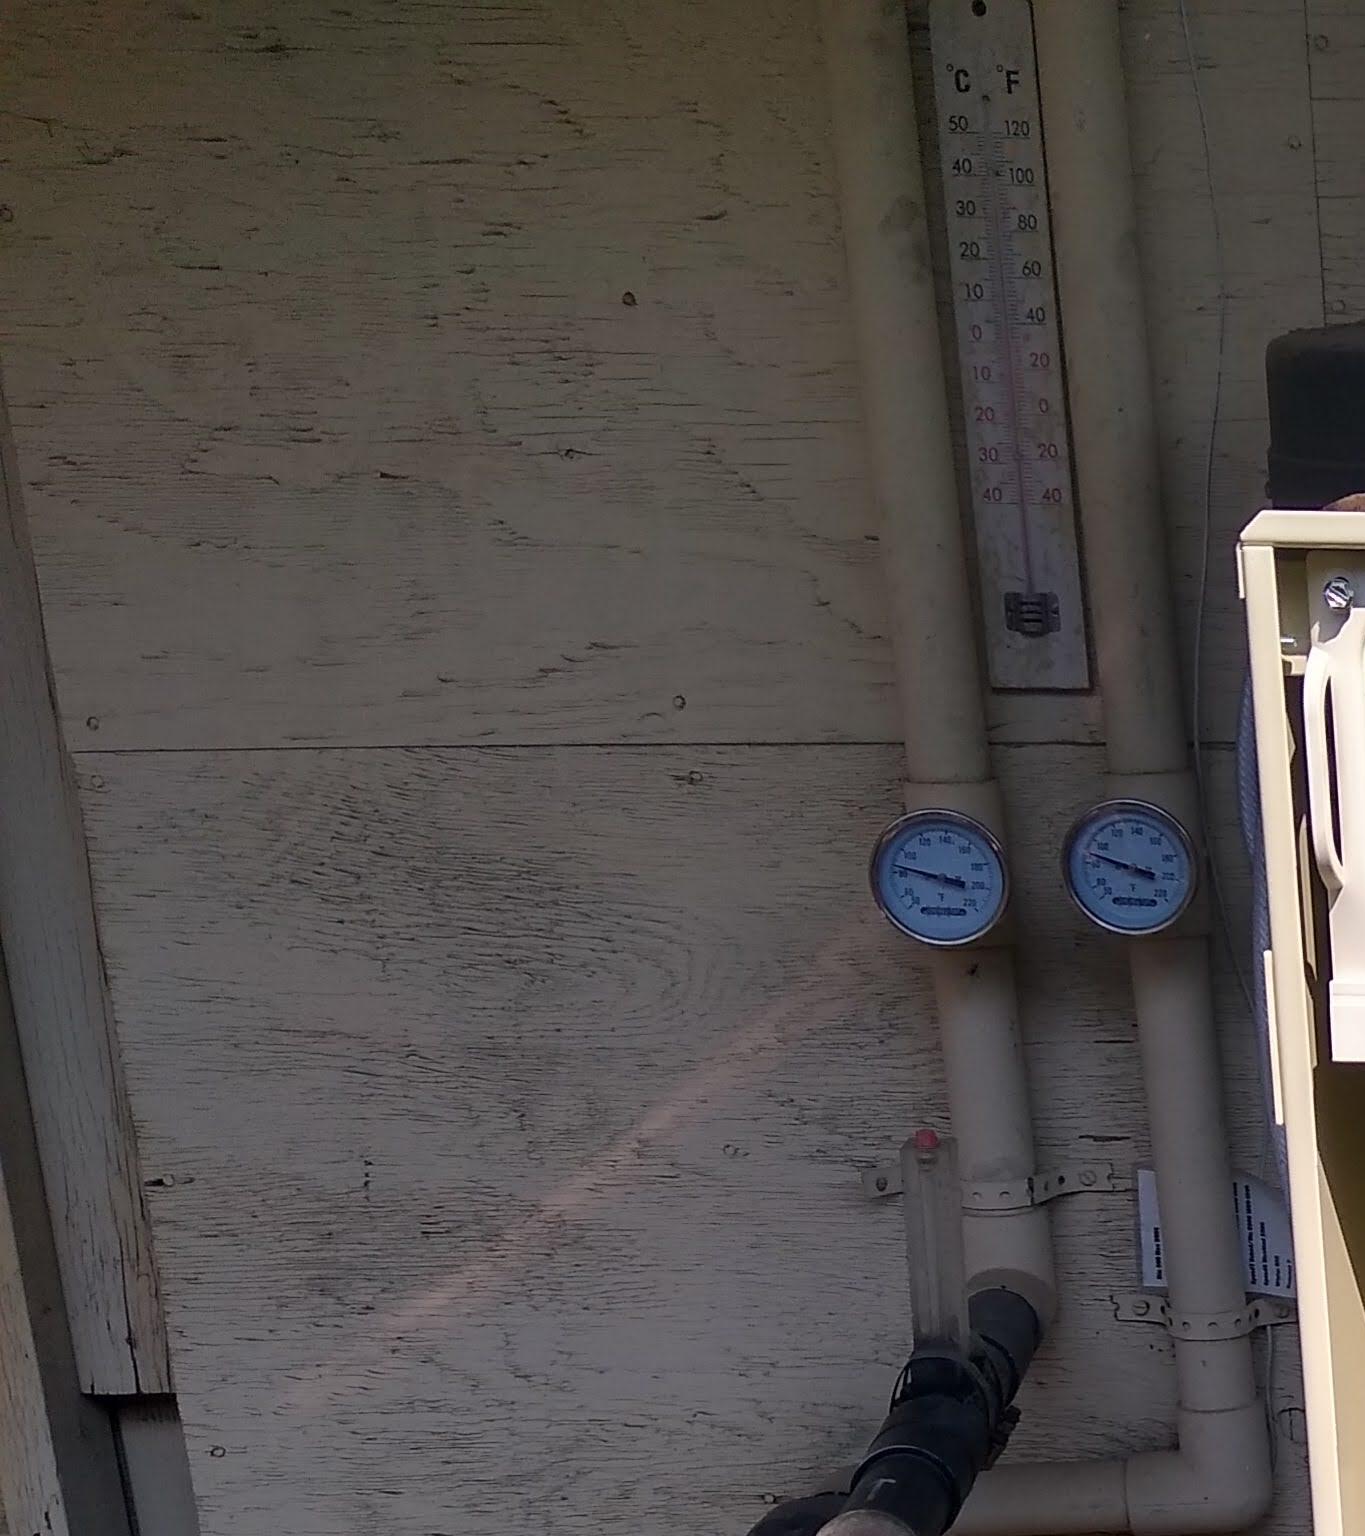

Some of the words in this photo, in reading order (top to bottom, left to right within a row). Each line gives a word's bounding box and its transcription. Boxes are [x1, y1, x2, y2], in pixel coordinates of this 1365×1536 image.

[949, 116, 968, 131] 50
[1005, 120, 1029, 136] 120
[952, 158, 971, 173] 40
[1010, 168, 1034, 183] 100
[956, 201, 976, 215] 30
[1018, 215, 1037, 230] 80
[960, 242, 980, 257] 20
[1023, 261, 1041, 276] 60
[965, 284, 983, 299] 10
[1027, 307, 1045, 322] 40
[972, 325, 982, 340] 0
[1031, 353, 1049, 368] 20
[974, 366, 991, 381] 10
[1040, 399, 1048, 414] 0
[976, 407, 994, 422] 20
[980, 447, 998, 462] 30
[1040, 443, 1058, 458] 20
[984, 488, 1002, 501] 40
[1043, 488, 1061, 502] 40
